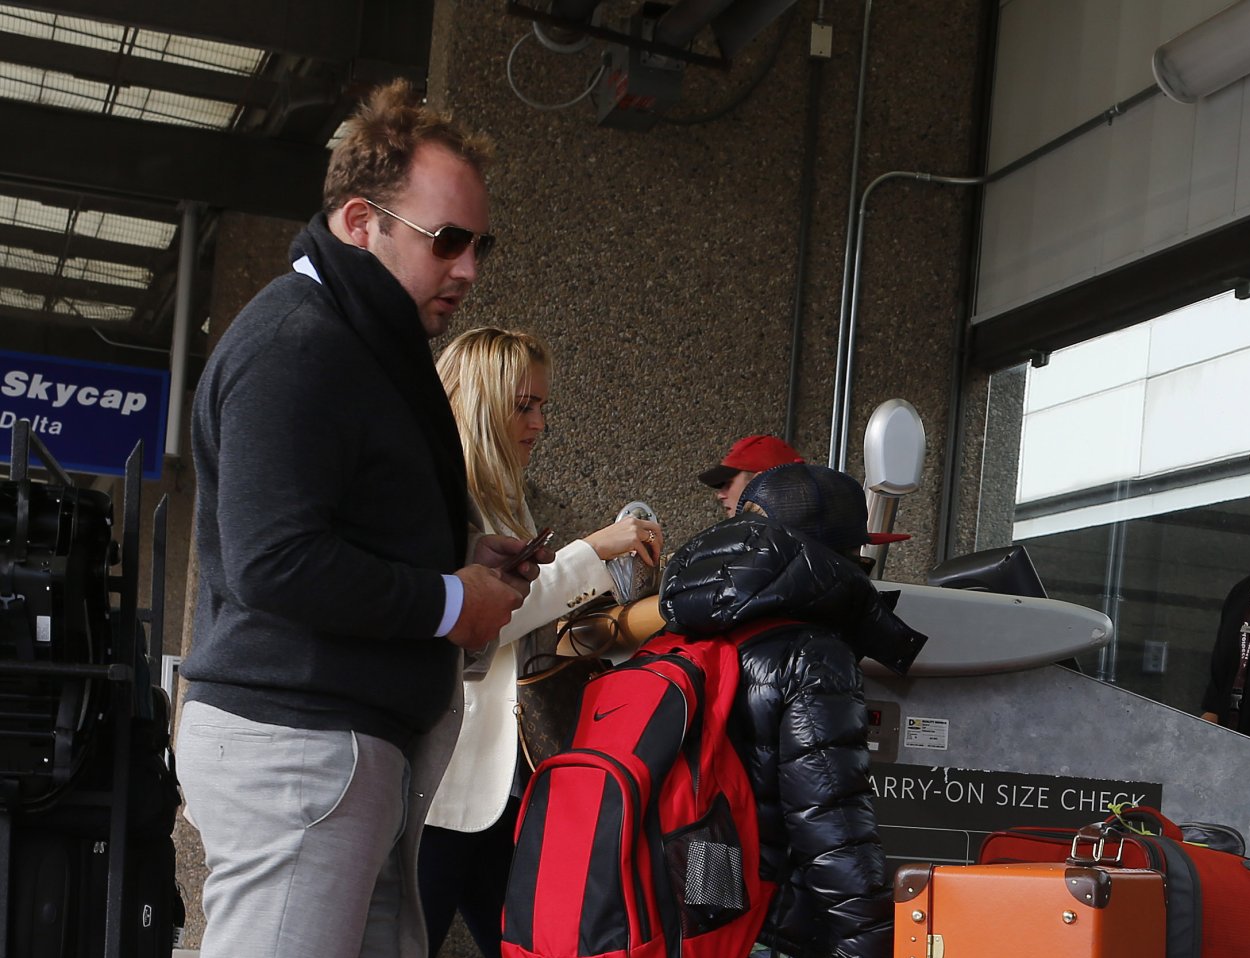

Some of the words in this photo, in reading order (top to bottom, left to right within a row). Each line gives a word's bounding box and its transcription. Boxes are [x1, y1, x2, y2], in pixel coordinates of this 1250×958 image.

[1, 370, 147, 415] Skycap
[0, 410, 63, 435] Dlta
[868, 775, 985, 804] ARRY-ON
[996, 784, 1050, 808] SIZE
